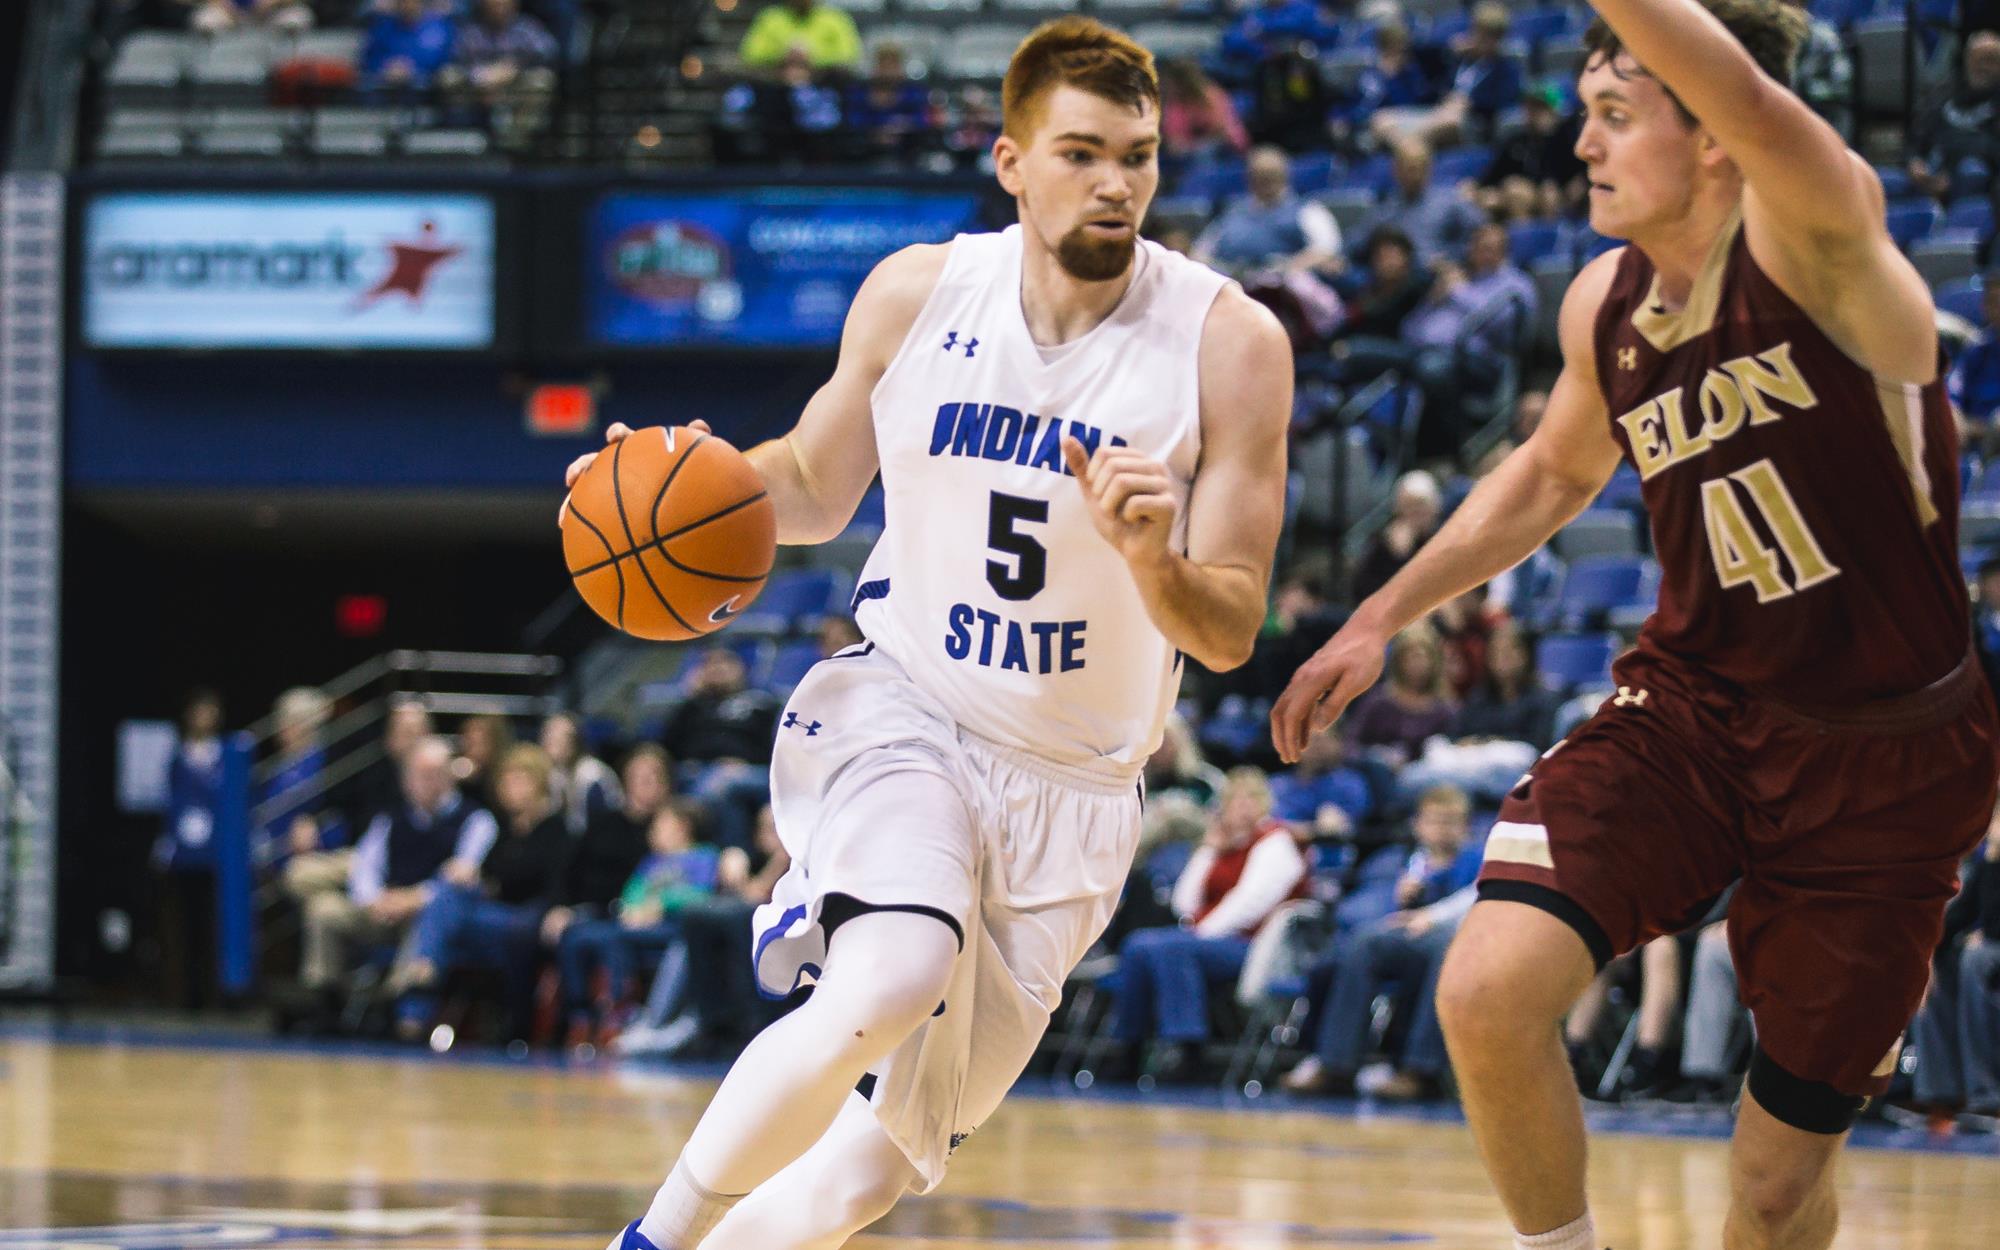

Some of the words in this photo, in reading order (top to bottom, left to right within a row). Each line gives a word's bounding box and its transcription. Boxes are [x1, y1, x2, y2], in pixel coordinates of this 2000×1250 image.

[99, 222, 364, 290] aramark
[929, 402, 1127, 477] INDIAN
[1616, 341, 1819, 482] ELON
[985, 489, 1050, 602] 5
[1700, 457, 1842, 605] 41
[944, 602, 1088, 675] STATE
